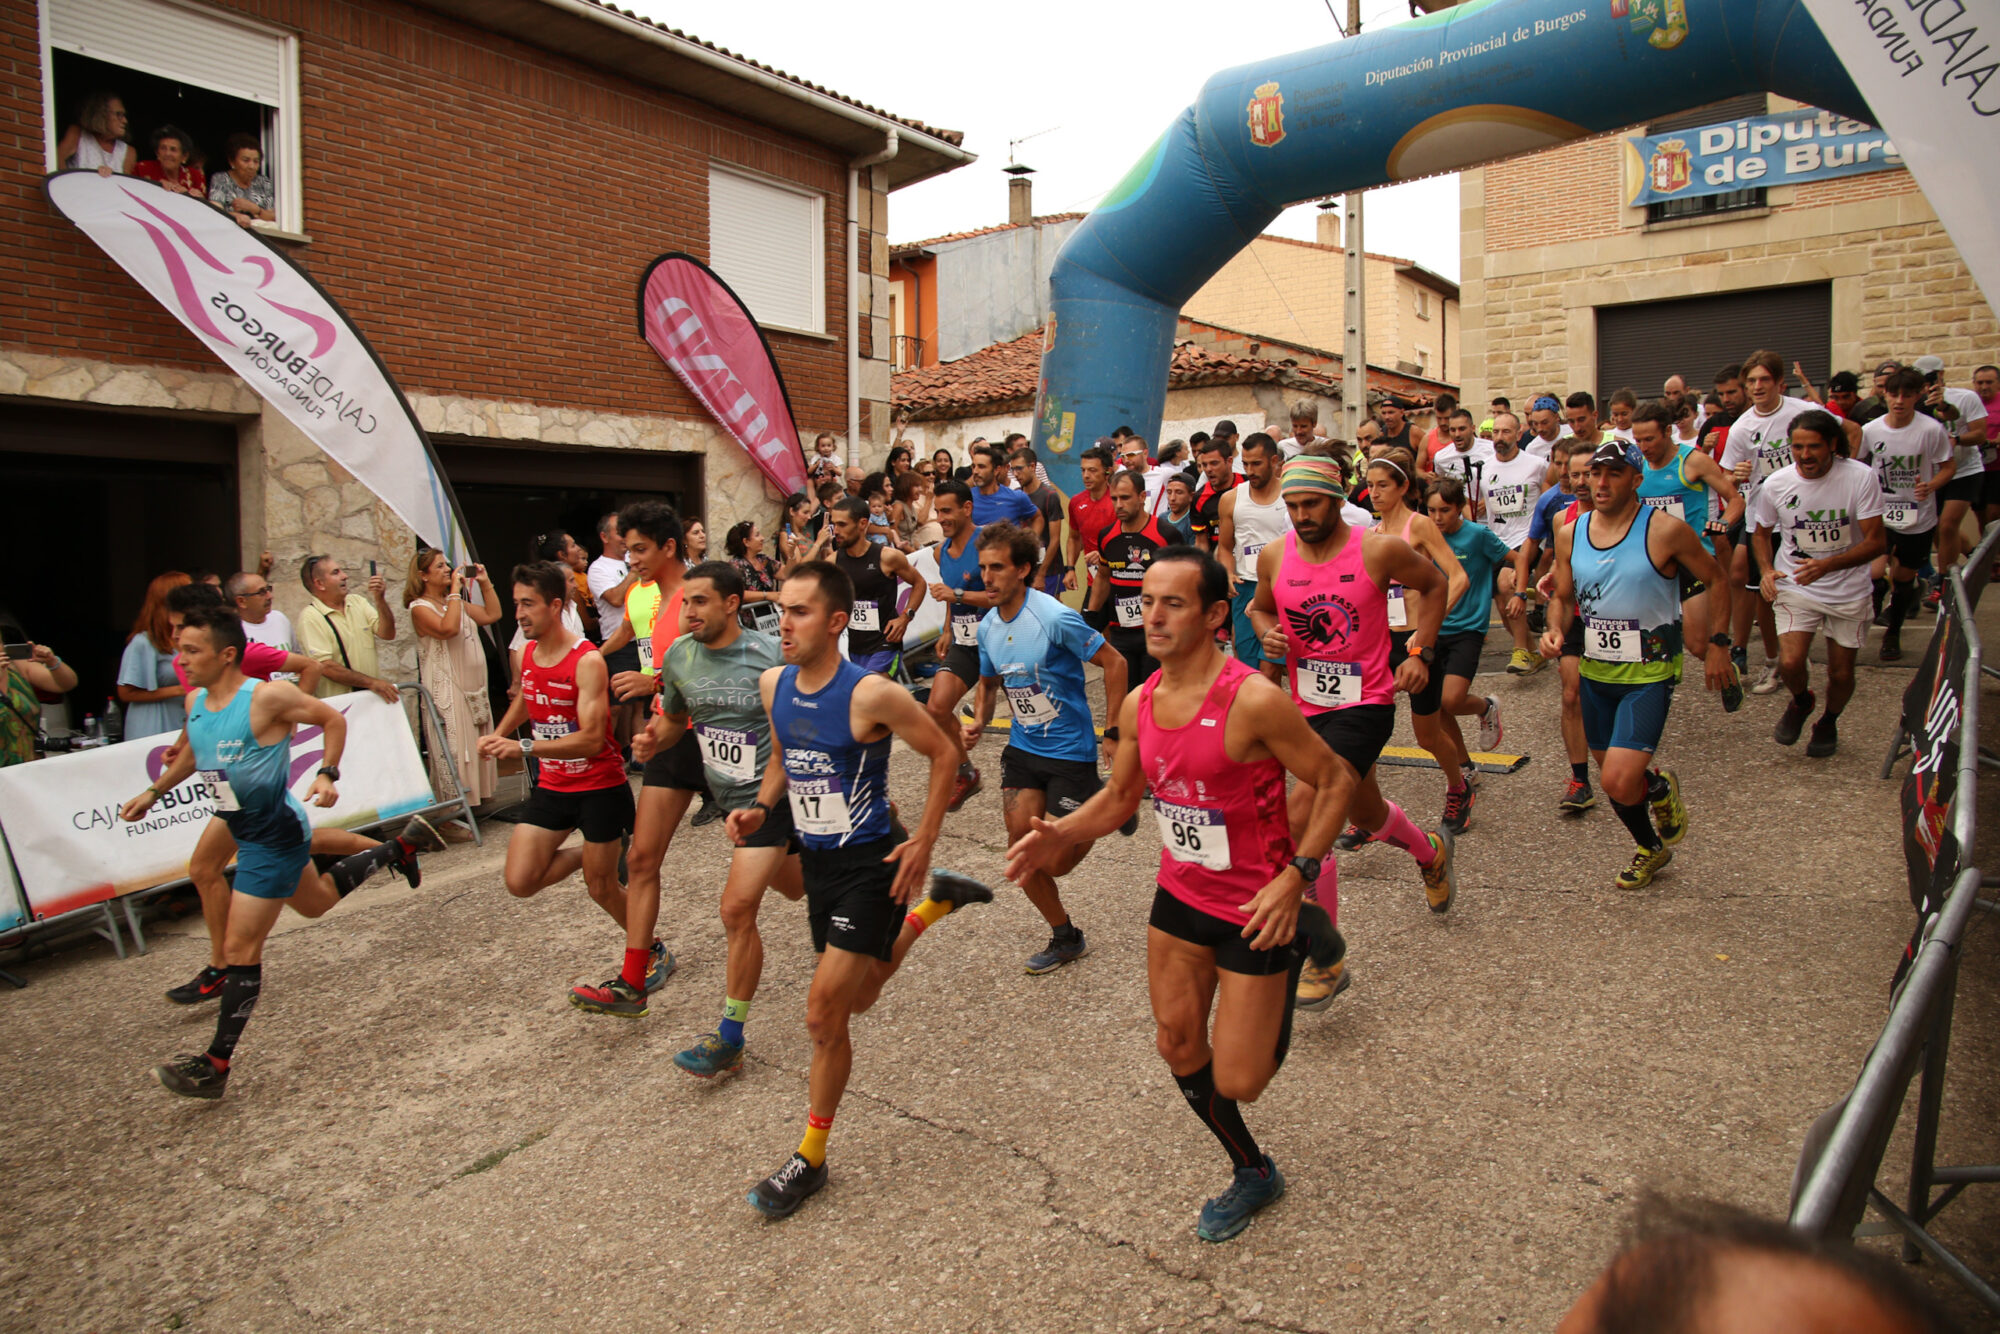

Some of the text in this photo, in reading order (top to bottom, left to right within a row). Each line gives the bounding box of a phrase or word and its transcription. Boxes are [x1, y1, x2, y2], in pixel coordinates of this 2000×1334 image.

[1365, 56, 1434, 87] Diputación
[1439, 32, 1507, 66] Provincial
[1512, 26, 1530, 43] de
[1534, 8, 1587, 37] Burgos
[1704, 155, 1768, 186] de
[1496, 494, 1518, 507] 104
[1886, 510, 1905, 522] 49
[1808, 528, 1841, 543] 110
[1300, 593, 1327, 611] RUN
[853, 609, 867, 622] 85
[1125, 604, 1142, 618] 94
[1331, 594, 1360, 632] FASTER
[961, 625, 970, 637] 2
[1589, 622, 1630, 631] BURGOS
[1597, 631, 1621, 649] 36
[1306, 659, 1352, 670] DIPUTACIÓN
[1306, 664, 1352, 676] BURGOS
[1315, 674, 1342, 695] 52
[686, 692, 758, 707] DESAFÍO
[1016, 699, 1036, 715] 66
[703, 731, 747, 745] BURGOS
[704, 726, 748, 739] DIPUTACIÓN
[708, 740, 742, 765] 100
[799, 796, 821, 819] 17
[1159, 800, 1210, 817] DIPUTACIÓN
[126, 804, 218, 838] FUNDACIÓN
[1160, 808, 1212, 826] BURGOS
[1172, 822, 1201, 851] 96
